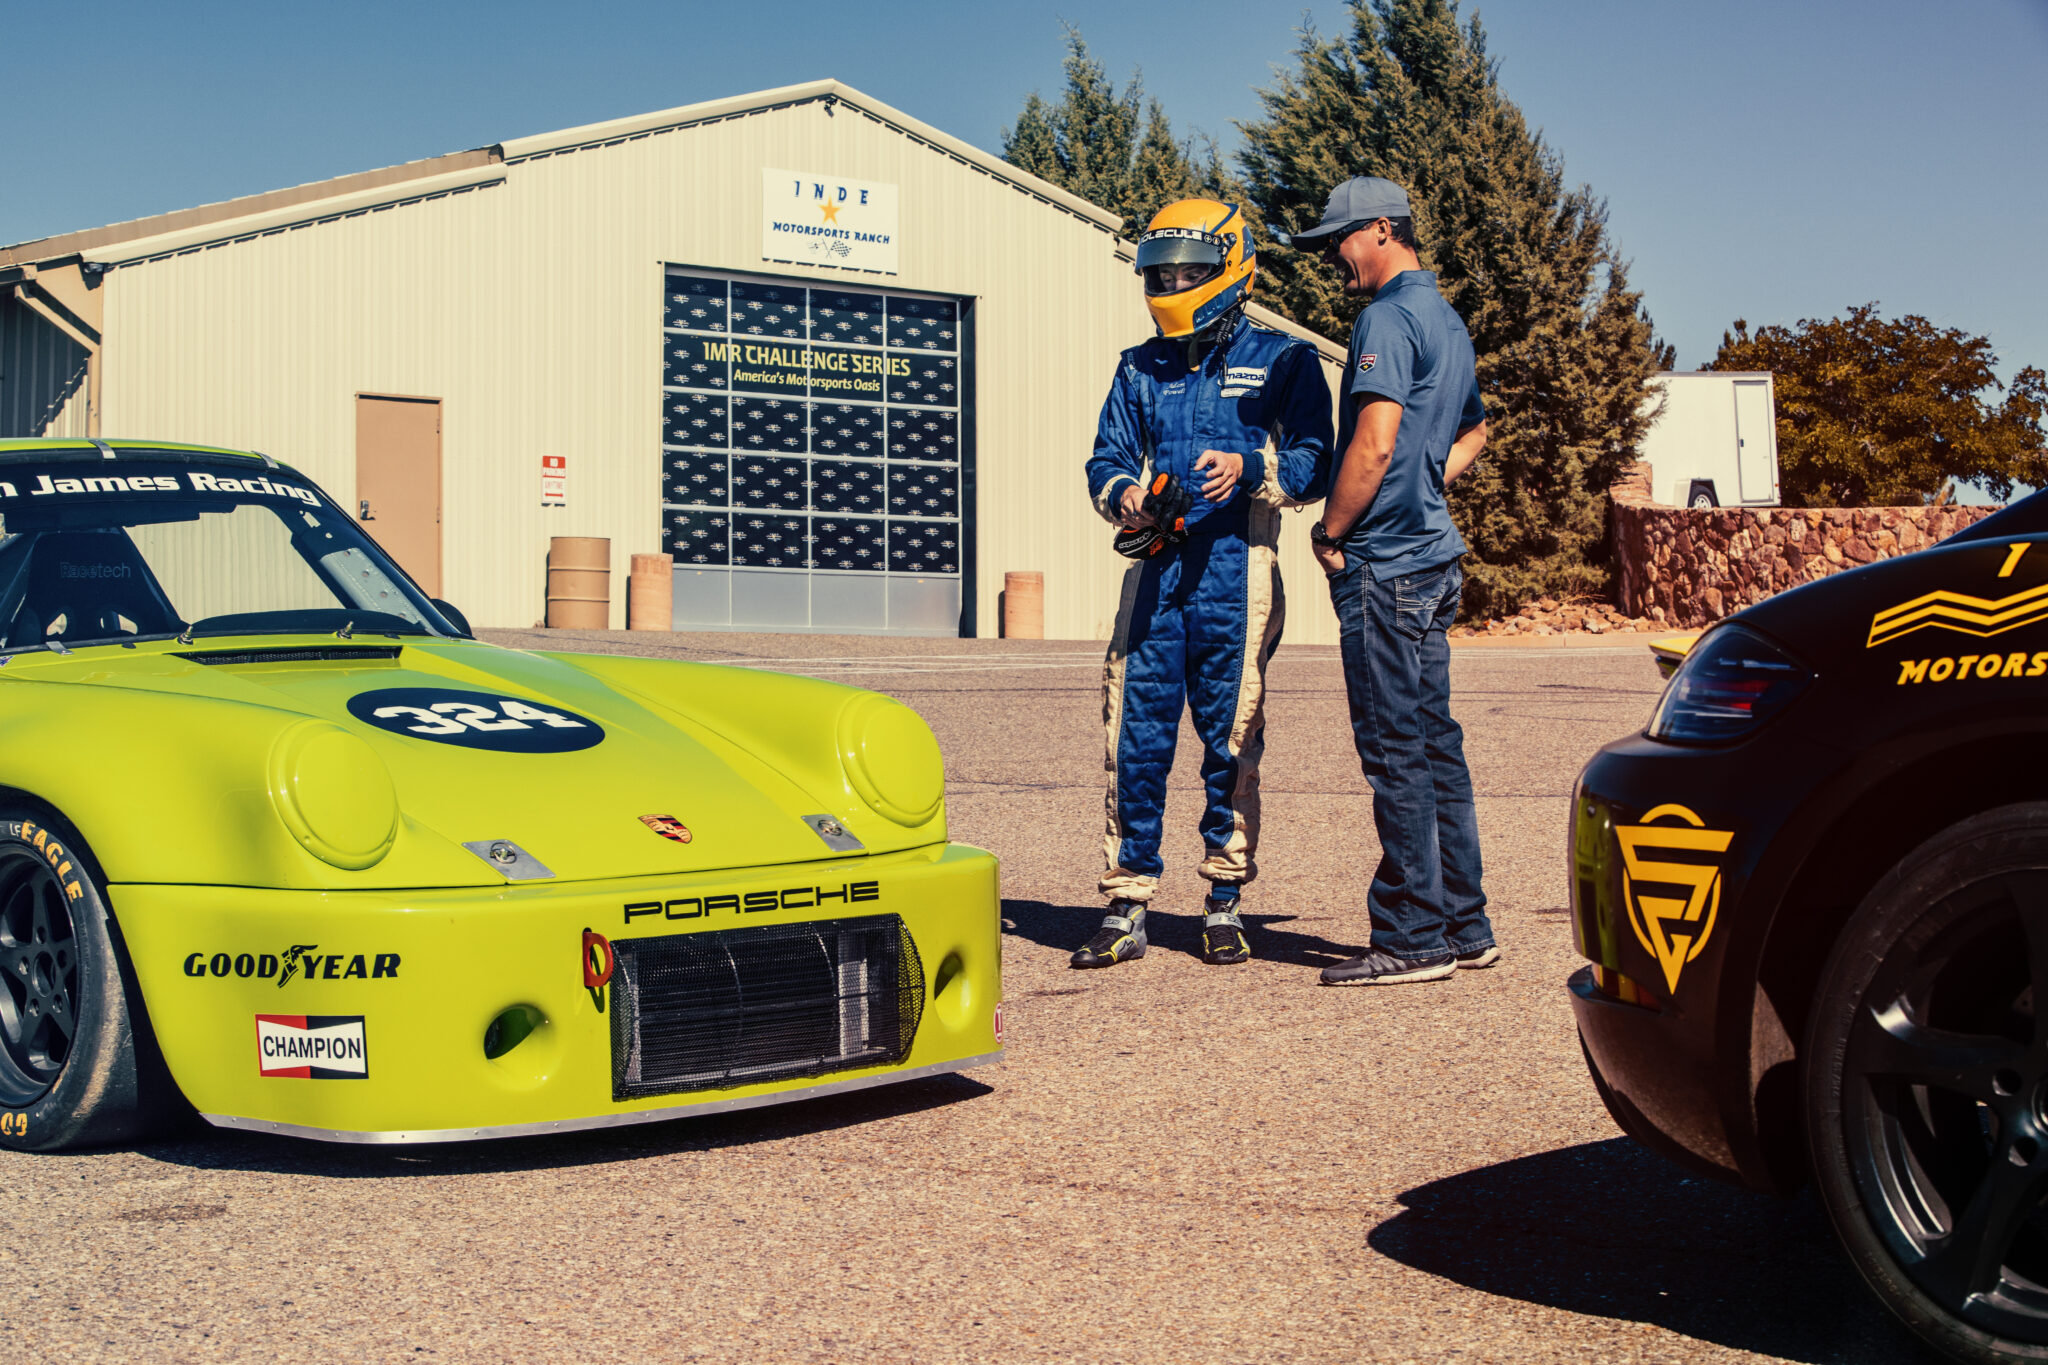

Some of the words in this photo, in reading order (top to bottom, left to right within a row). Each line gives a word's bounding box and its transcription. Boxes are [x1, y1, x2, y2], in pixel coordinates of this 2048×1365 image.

[794, 180, 869, 205] INDE
[773, 221, 850, 240] MOTORSPORTS
[854, 231, 890, 244] RANCH
[703, 341, 743, 363] IMR
[745, 345, 849, 372] CHALLENGE
[851, 354, 911, 377] SERIES
[733, 369, 784, 385] America's
[786, 373, 852, 391] Motorsports
[854, 379, 880, 392] Oasis
[30, 474, 181, 496] James
[187, 472, 323, 507] Racing
[59, 561, 131, 579] Racetech
[1896, 651, 2048, 686] MOTORS
[372, 700, 588, 735] 324
[21, 819, 84, 904] EAGLE
[623, 880, 880, 924] PORSCHE
[263, 1035, 362, 1060] CHAMPION
